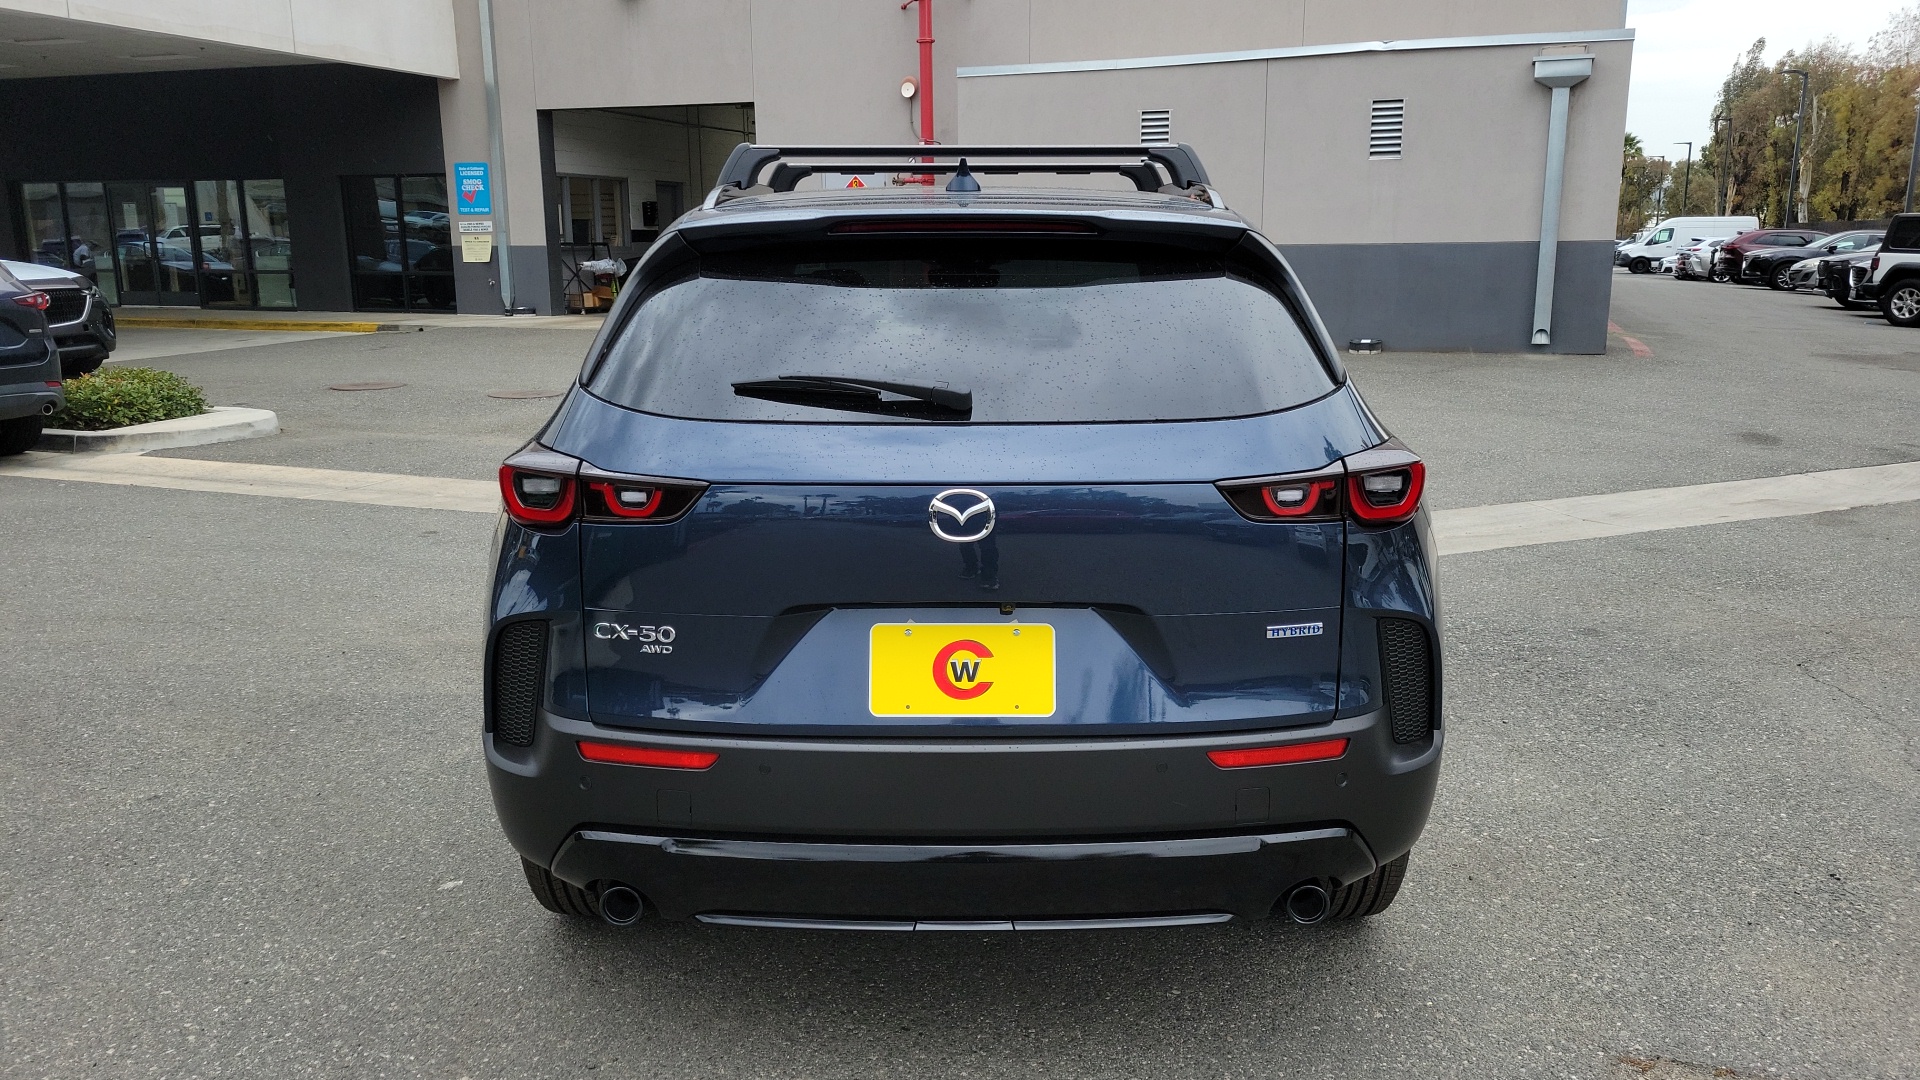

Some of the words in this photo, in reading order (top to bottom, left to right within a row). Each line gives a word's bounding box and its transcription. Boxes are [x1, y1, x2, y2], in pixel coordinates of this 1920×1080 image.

[594, 622, 676, 643] CX-50
[1271, 624, 1321, 637] HYBRID
[640, 644, 673, 654] AWD
